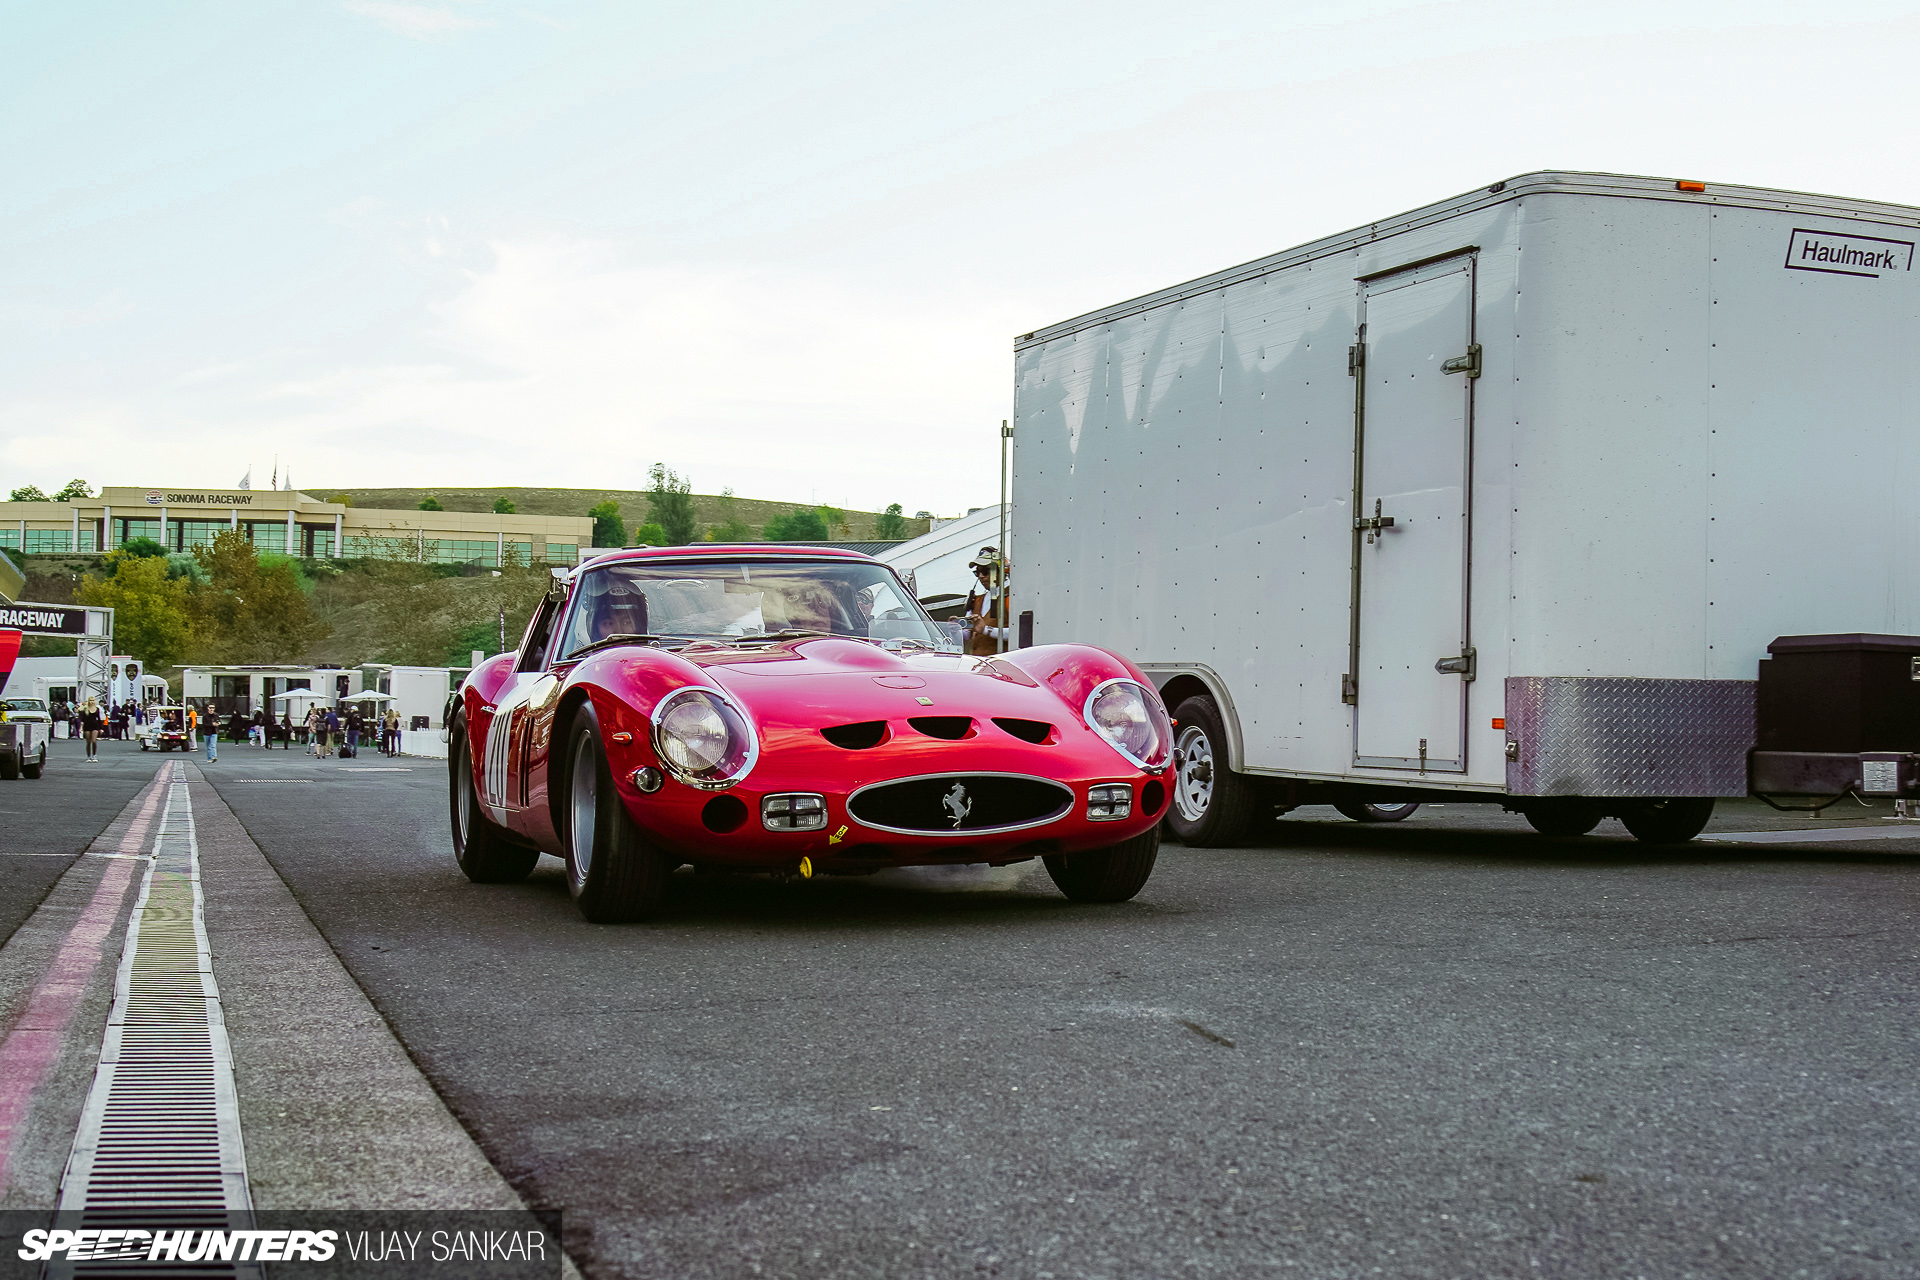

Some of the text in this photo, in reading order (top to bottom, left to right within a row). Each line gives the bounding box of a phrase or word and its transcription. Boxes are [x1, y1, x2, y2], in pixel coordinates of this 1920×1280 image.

[1801, 240, 1896, 269] Haulmark
[167, 494, 205, 503] SONOMA
[208, 495, 252, 504] RACEWAY
[0, 610, 65, 628] RACEWAY
